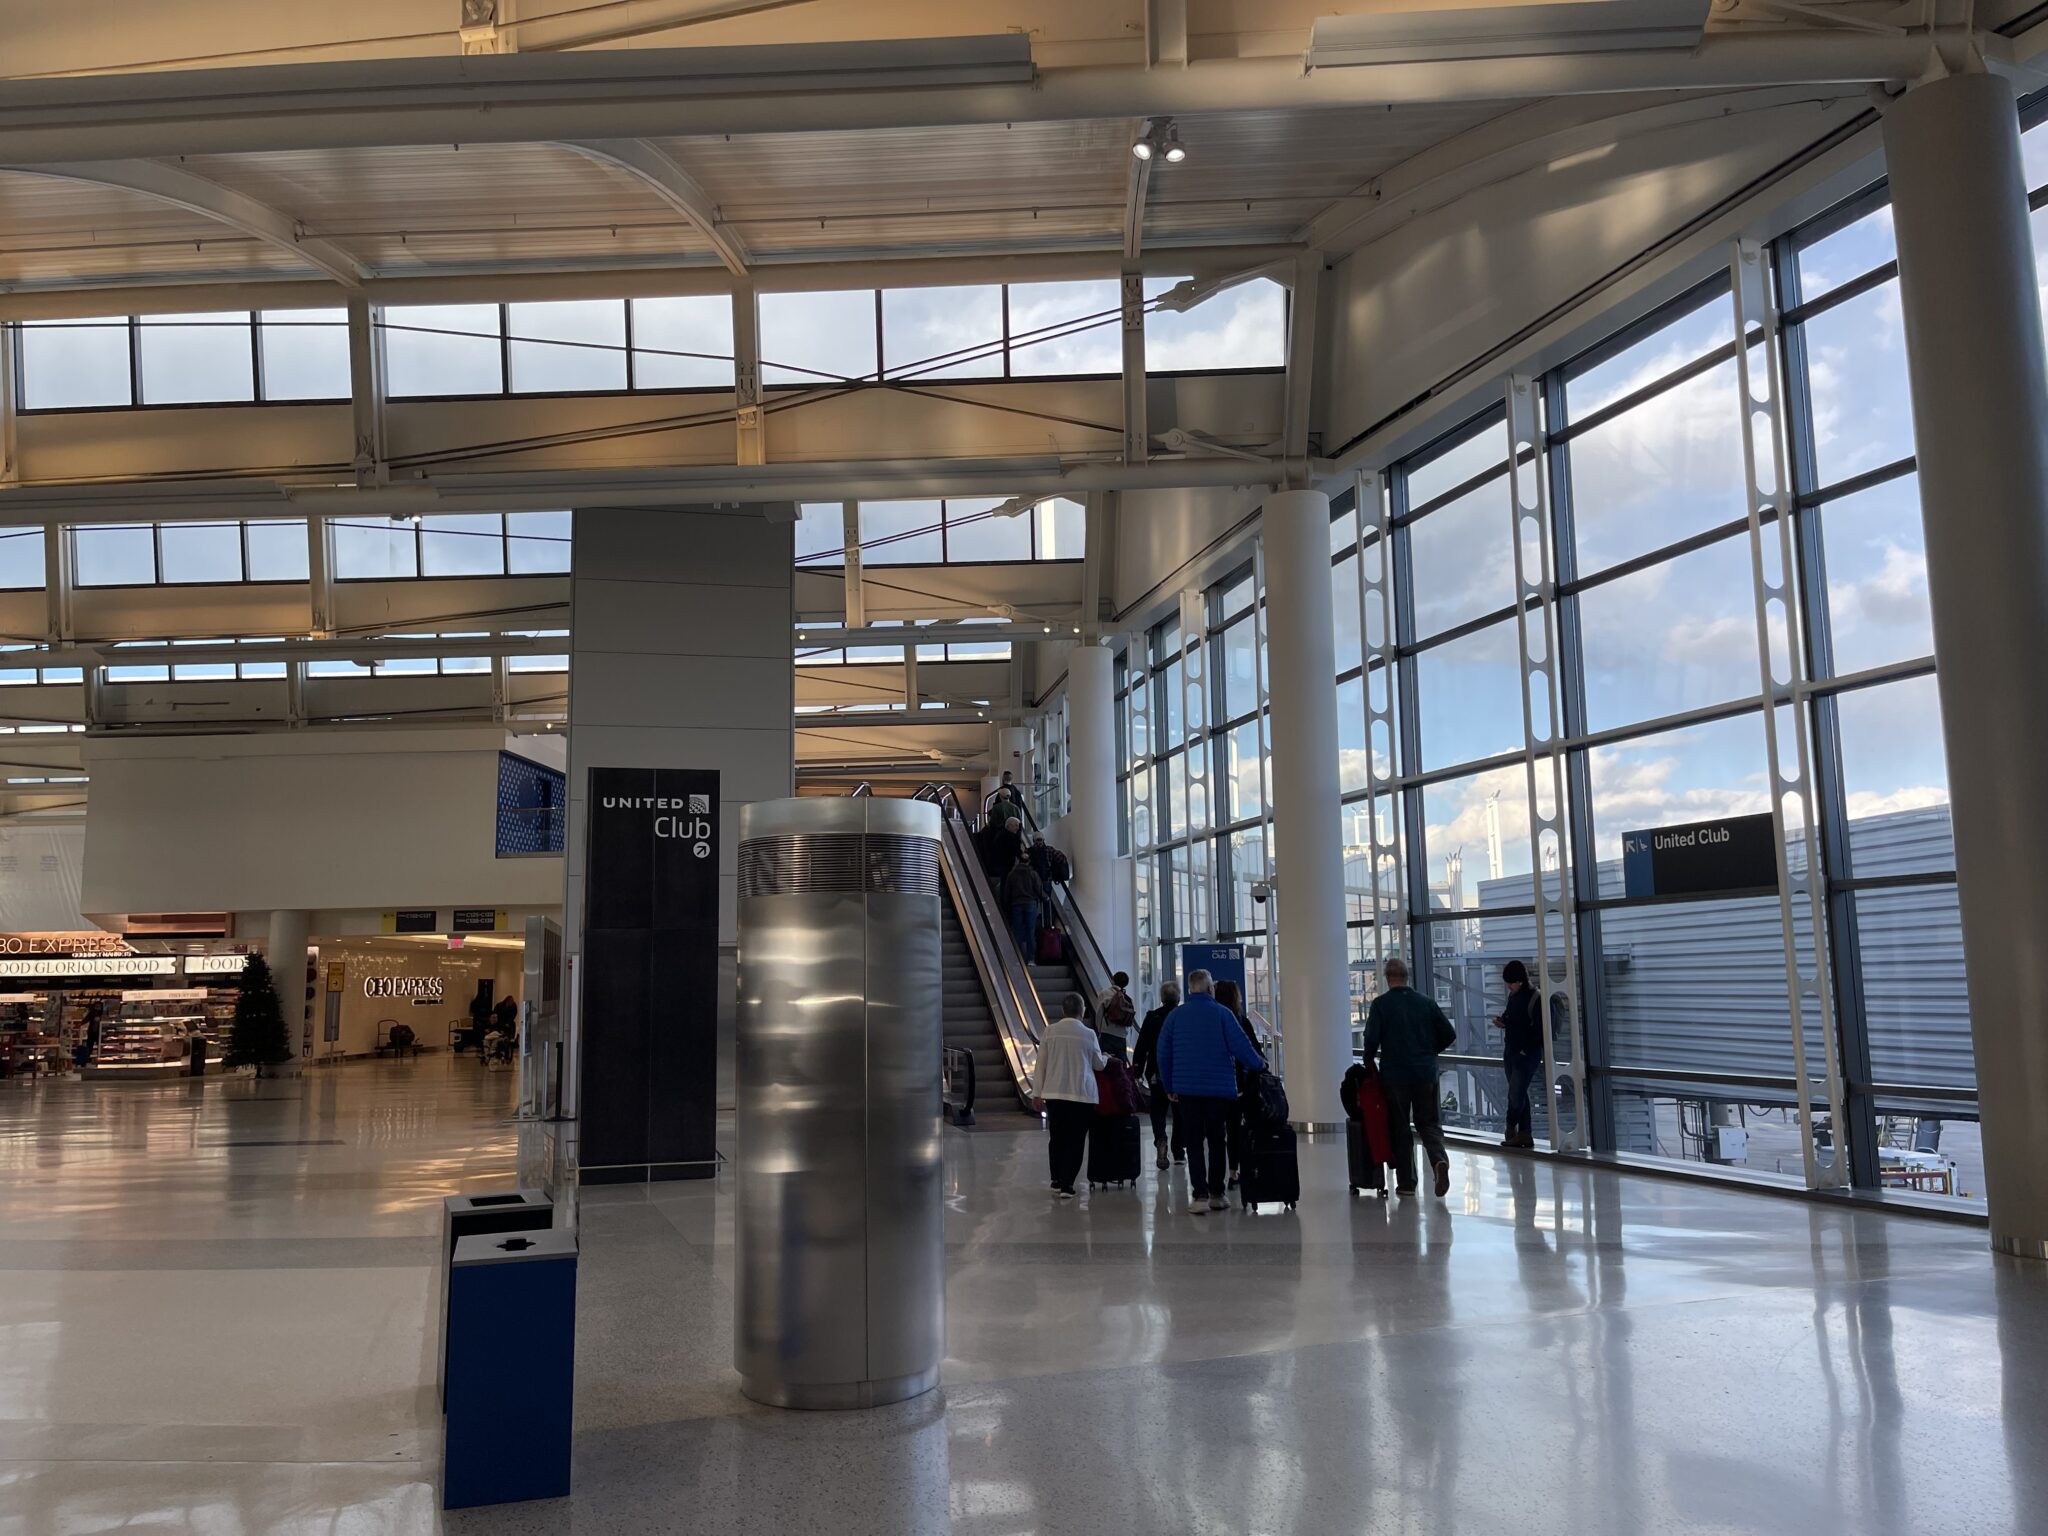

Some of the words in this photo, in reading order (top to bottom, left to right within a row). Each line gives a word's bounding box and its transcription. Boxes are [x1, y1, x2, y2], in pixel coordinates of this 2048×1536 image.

[603, 797, 683, 809] UNITED
[655, 816, 711, 839] Club
[1654, 831, 1695, 850] United
[1699, 827, 1730, 845] Club
[29, 936, 132, 953] EXPRESS
[34, 960, 113, 975] GLORIOUS
[117, 959, 160, 973] FOOD
[201, 957, 245, 971] FOOD
[393, 976, 444, 997] EXPRESS
